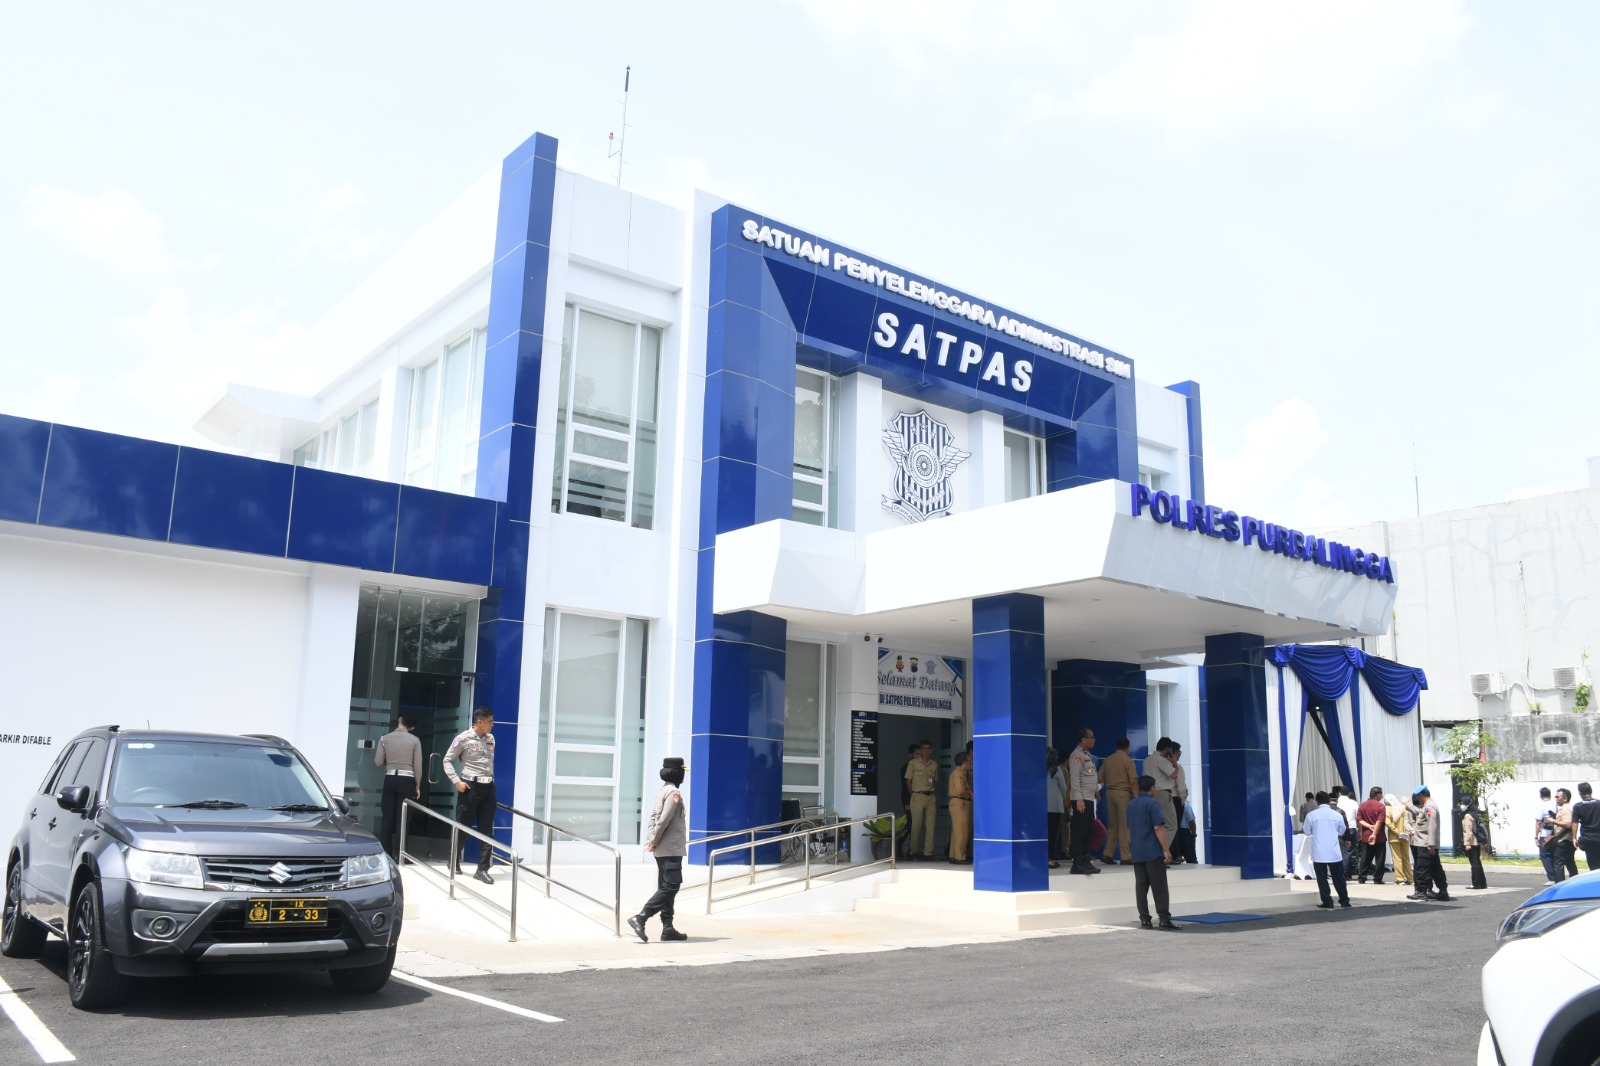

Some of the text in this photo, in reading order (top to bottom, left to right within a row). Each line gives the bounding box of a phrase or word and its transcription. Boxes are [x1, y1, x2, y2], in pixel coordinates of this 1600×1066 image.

[742, 219, 1131, 379] SATUAN PENYELENGGARA ADMINISTRASI SIM
[873, 312, 1033, 393] SATPAS
[1131, 483, 1394, 584] POLRES PURBALINGGA
[920, 676, 957, 696] Datang
[879, 693, 952, 710] DI SATPAS POLRES PURBALINGGA
[22, 735, 52, 745] DIFABLE
[279, 909, 285, 920] 2
[304, 909, 318, 920] 33
